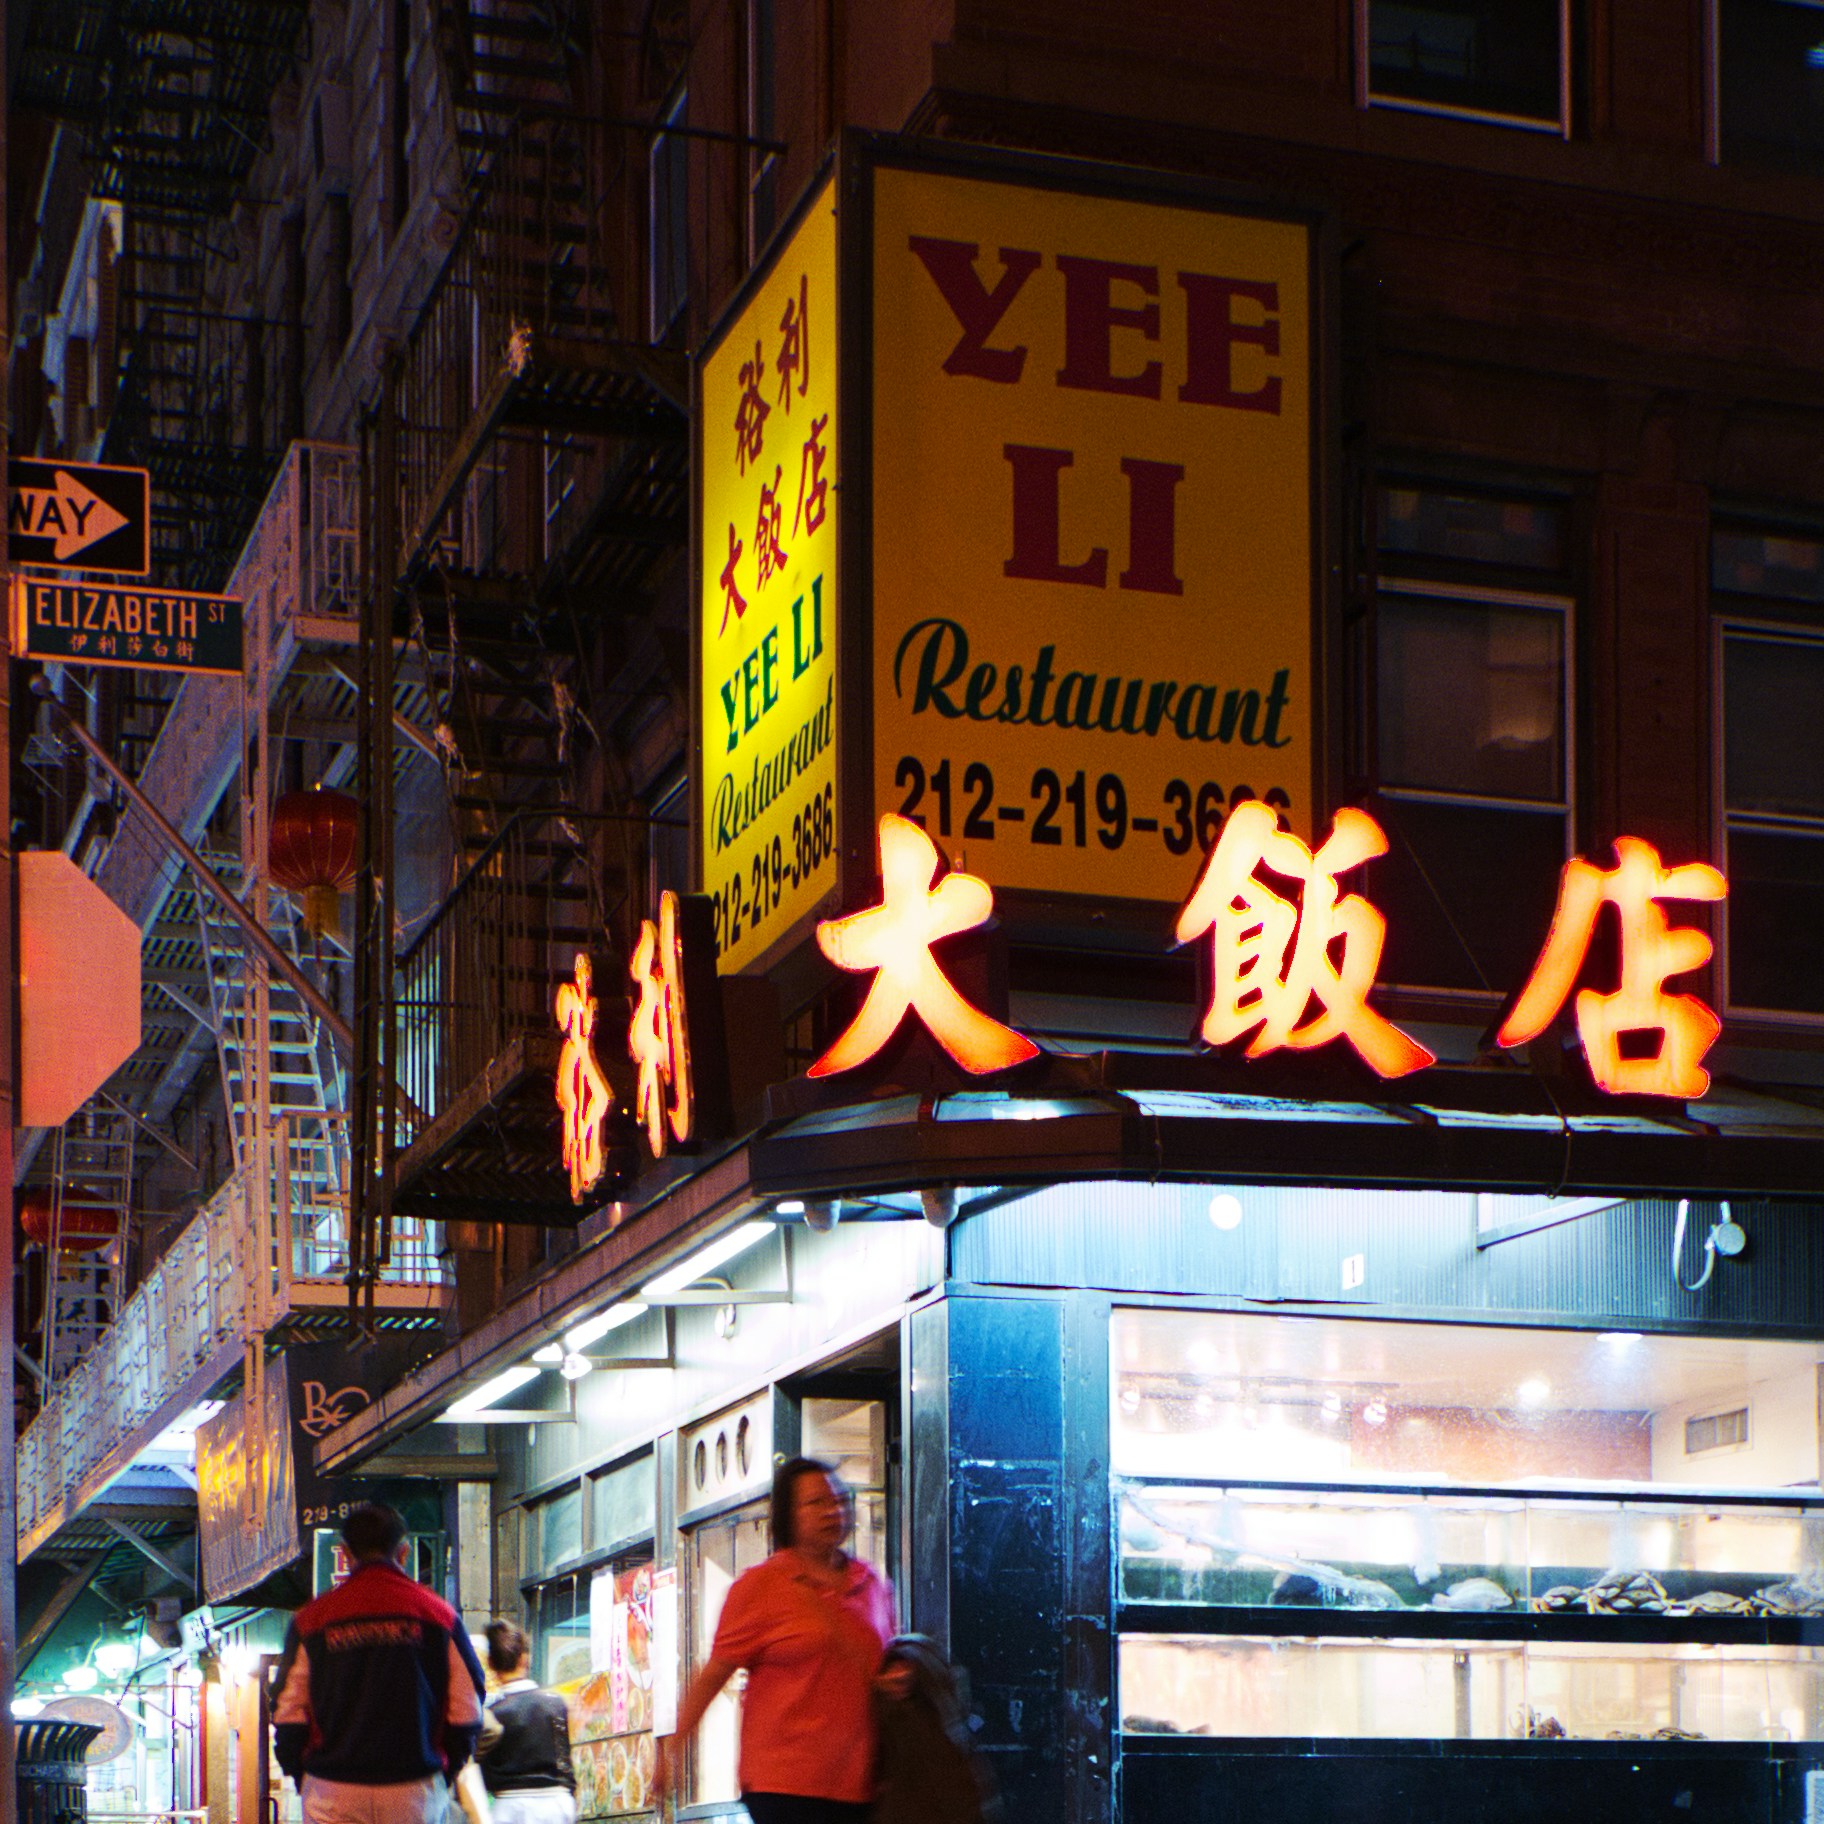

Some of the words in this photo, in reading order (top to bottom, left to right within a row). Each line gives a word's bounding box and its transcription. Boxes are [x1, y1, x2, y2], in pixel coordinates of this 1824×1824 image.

[732, 272, 811, 478] 裕利
[908, 234, 1284, 417] YEE
[8, 485, 99, 538] WAY
[717, 412, 830, 638] 大飯店
[1002, 443, 1186, 598] LI
[35, 586, 197, 640] ELIZABETH
[208, 602, 226, 625] ST
[69, 632, 196, 662] 伊利莎白街
[719, 622, 779, 753] YEE
[791, 572, 827, 682] LI
[893, 616, 1292, 749] Restaurant
[711, 674, 834, 857] Restaurant
[894, 755, 1292, 857] 212-219-36
[805, 796, 1729, 1100] 大飯店
